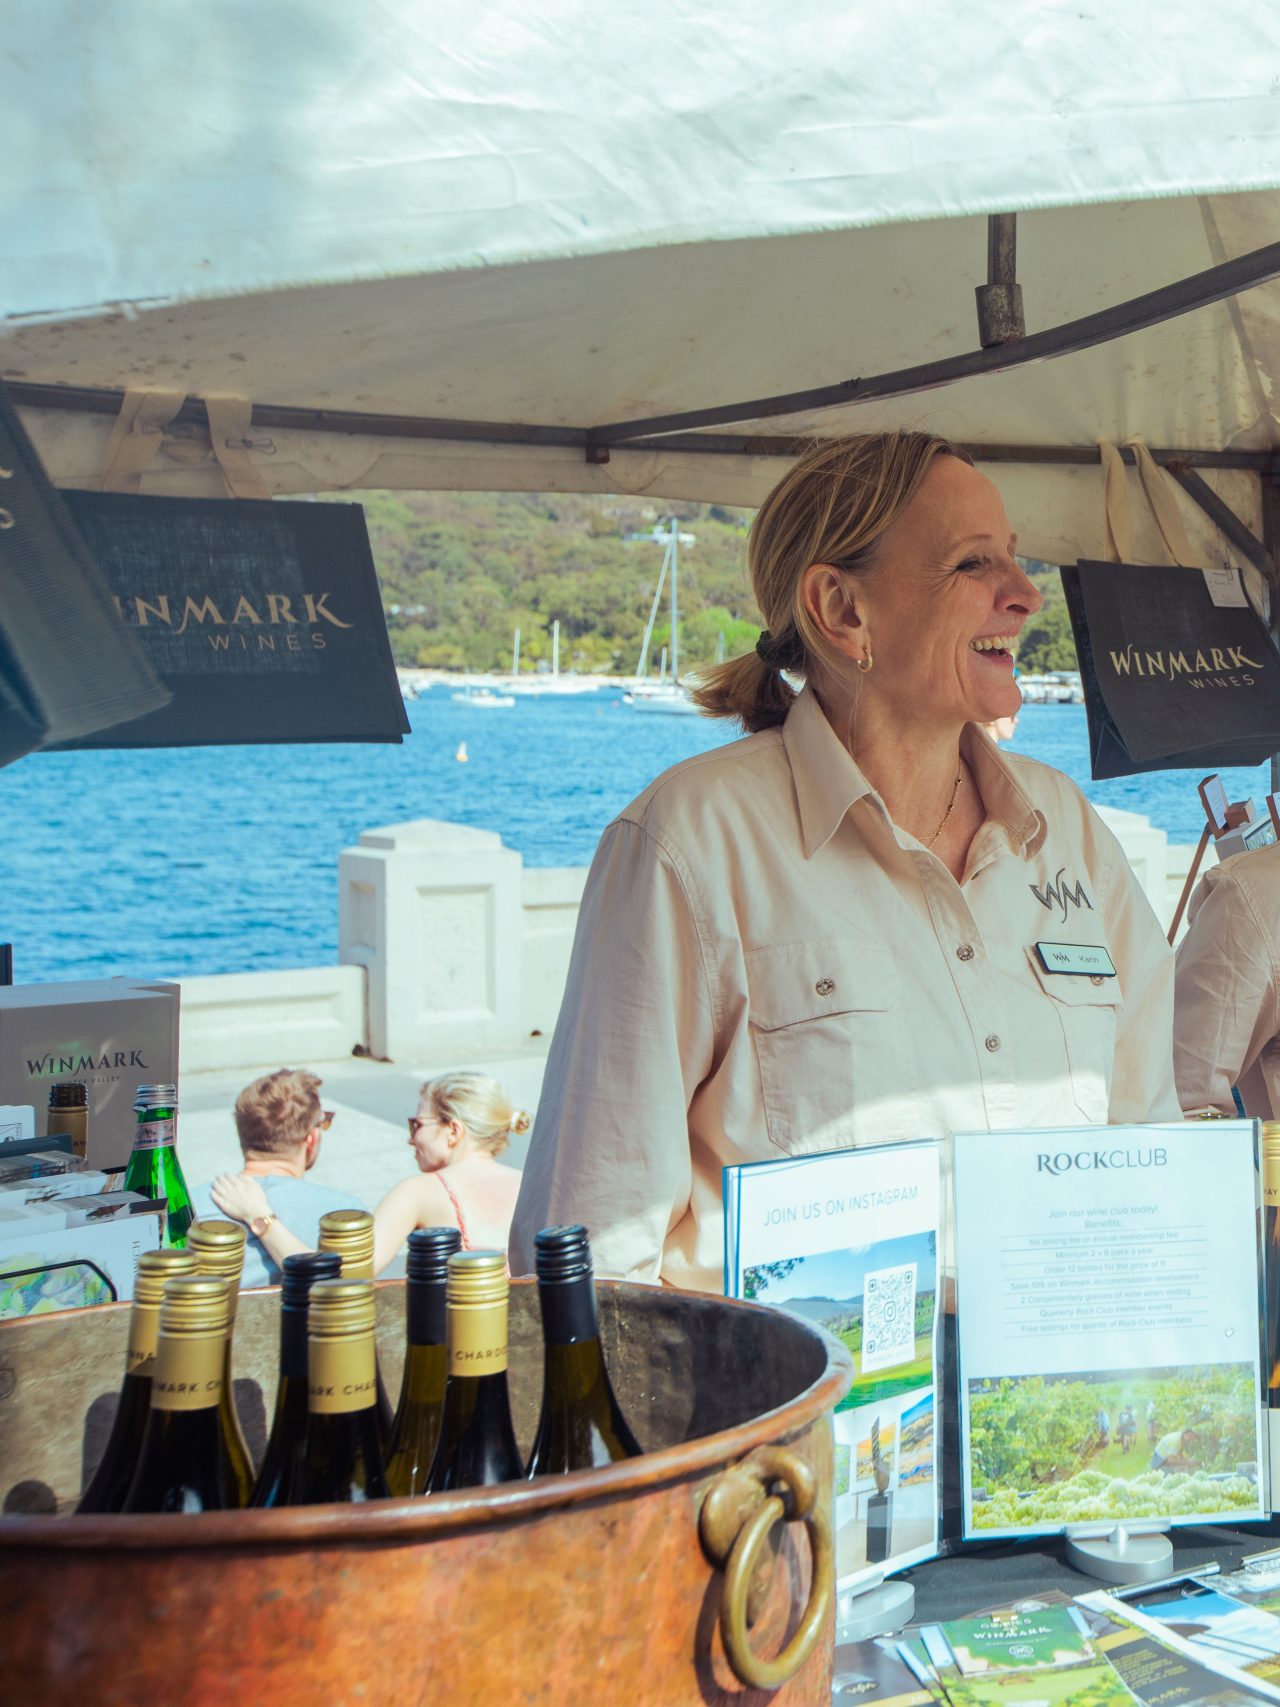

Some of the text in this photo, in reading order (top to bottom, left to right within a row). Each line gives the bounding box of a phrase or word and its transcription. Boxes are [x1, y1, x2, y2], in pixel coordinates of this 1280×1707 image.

[112, 592, 354, 635] INMARK
[208, 633, 327, 651] WINES
[1109, 643, 1265, 682] WINMARK
[1189, 674, 1255, 689] WINES
[26, 1050, 149, 1077] WINMARK
[1037, 1148, 1168, 1175] ROCKCLUB
[763, 1186, 919, 1227] JOIN US ON INSTAGRAM
[1048, 1208, 1067, 1218] Join
[1069, 1209, 1085, 1217] our
[1086, 1207, 1107, 1216] wine
[1109, 1205, 1129, 1215] club
[1055, 1250, 1089, 1258] Minimum
[1068, 1264, 1076, 1272] 12
